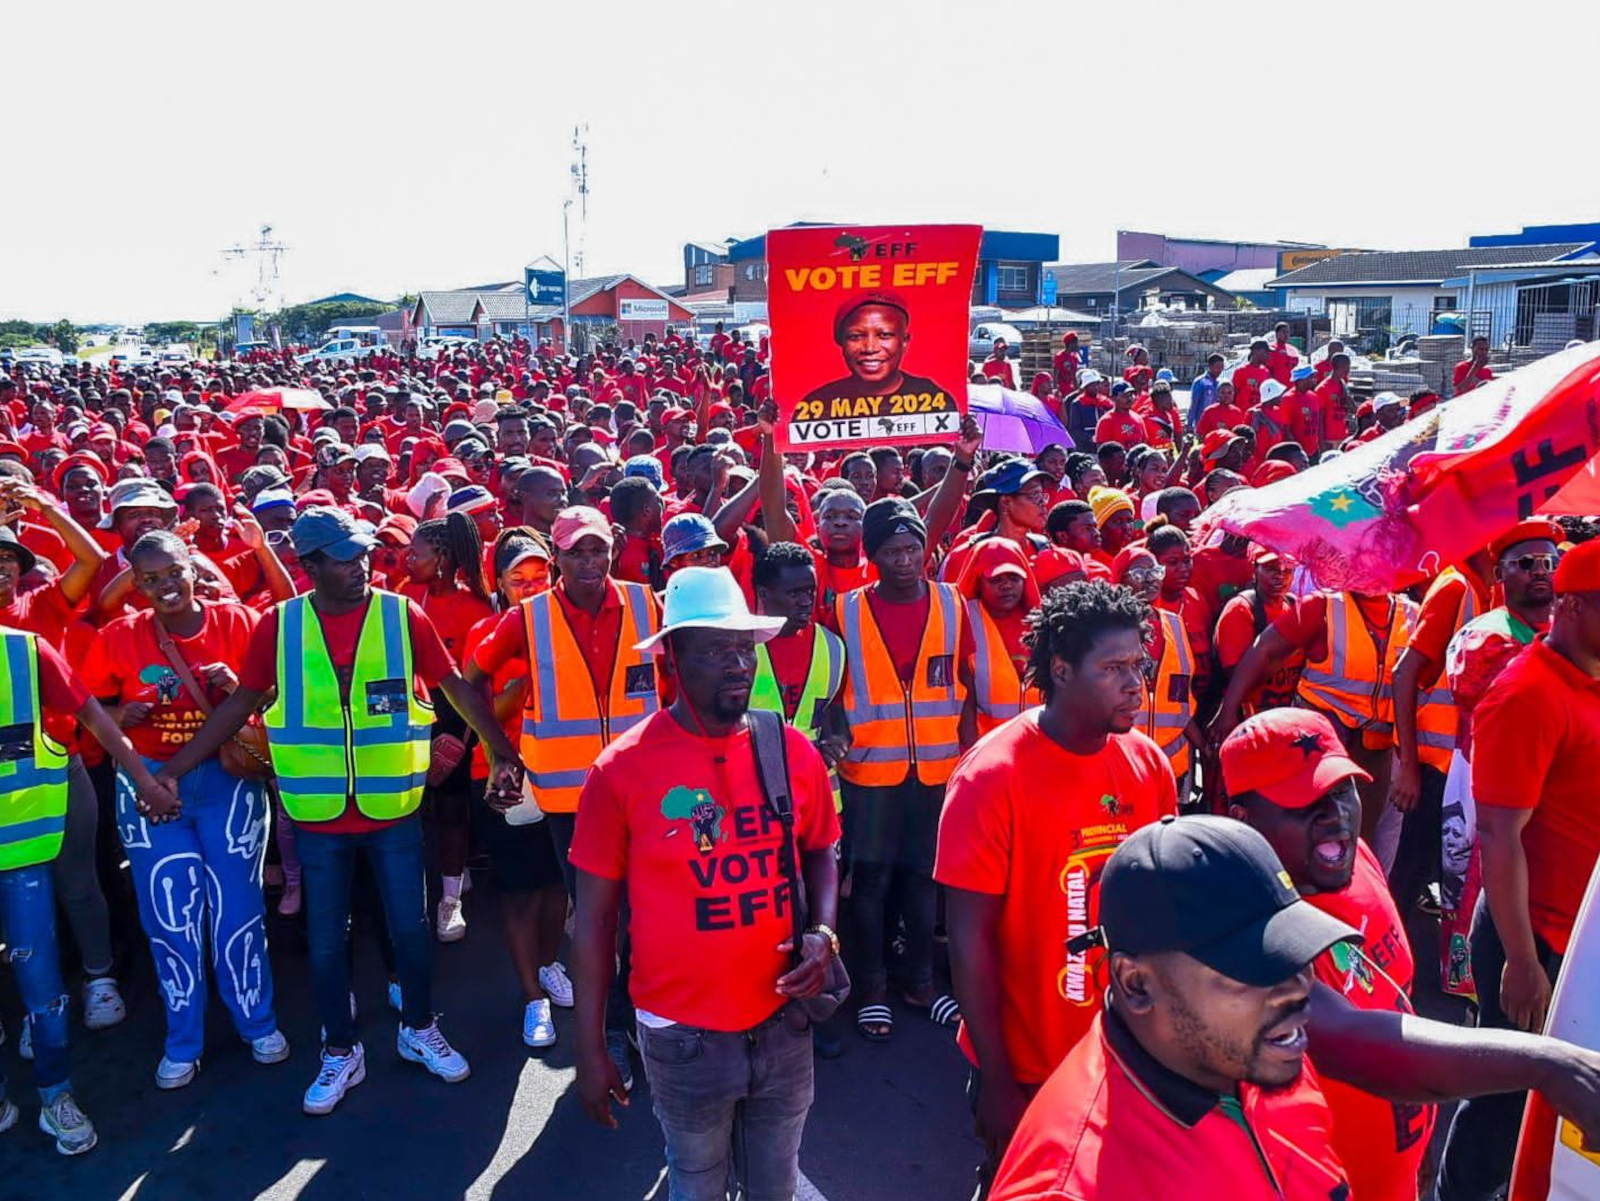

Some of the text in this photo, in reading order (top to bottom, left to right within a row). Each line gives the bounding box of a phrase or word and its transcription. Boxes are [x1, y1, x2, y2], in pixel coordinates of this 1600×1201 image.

[875, 242, 919, 258] EFF
[785, 261, 959, 291] VOTE EFF
[633, 304, 667, 313] Microsoft
[795, 392, 947, 421] 29 MAY 2024
[795, 420, 862, 441] VOTE
[897, 422, 916, 432] EFF
[734, 803, 784, 838] EF
[1065, 869, 1087, 1002] KWAZU NATAL
